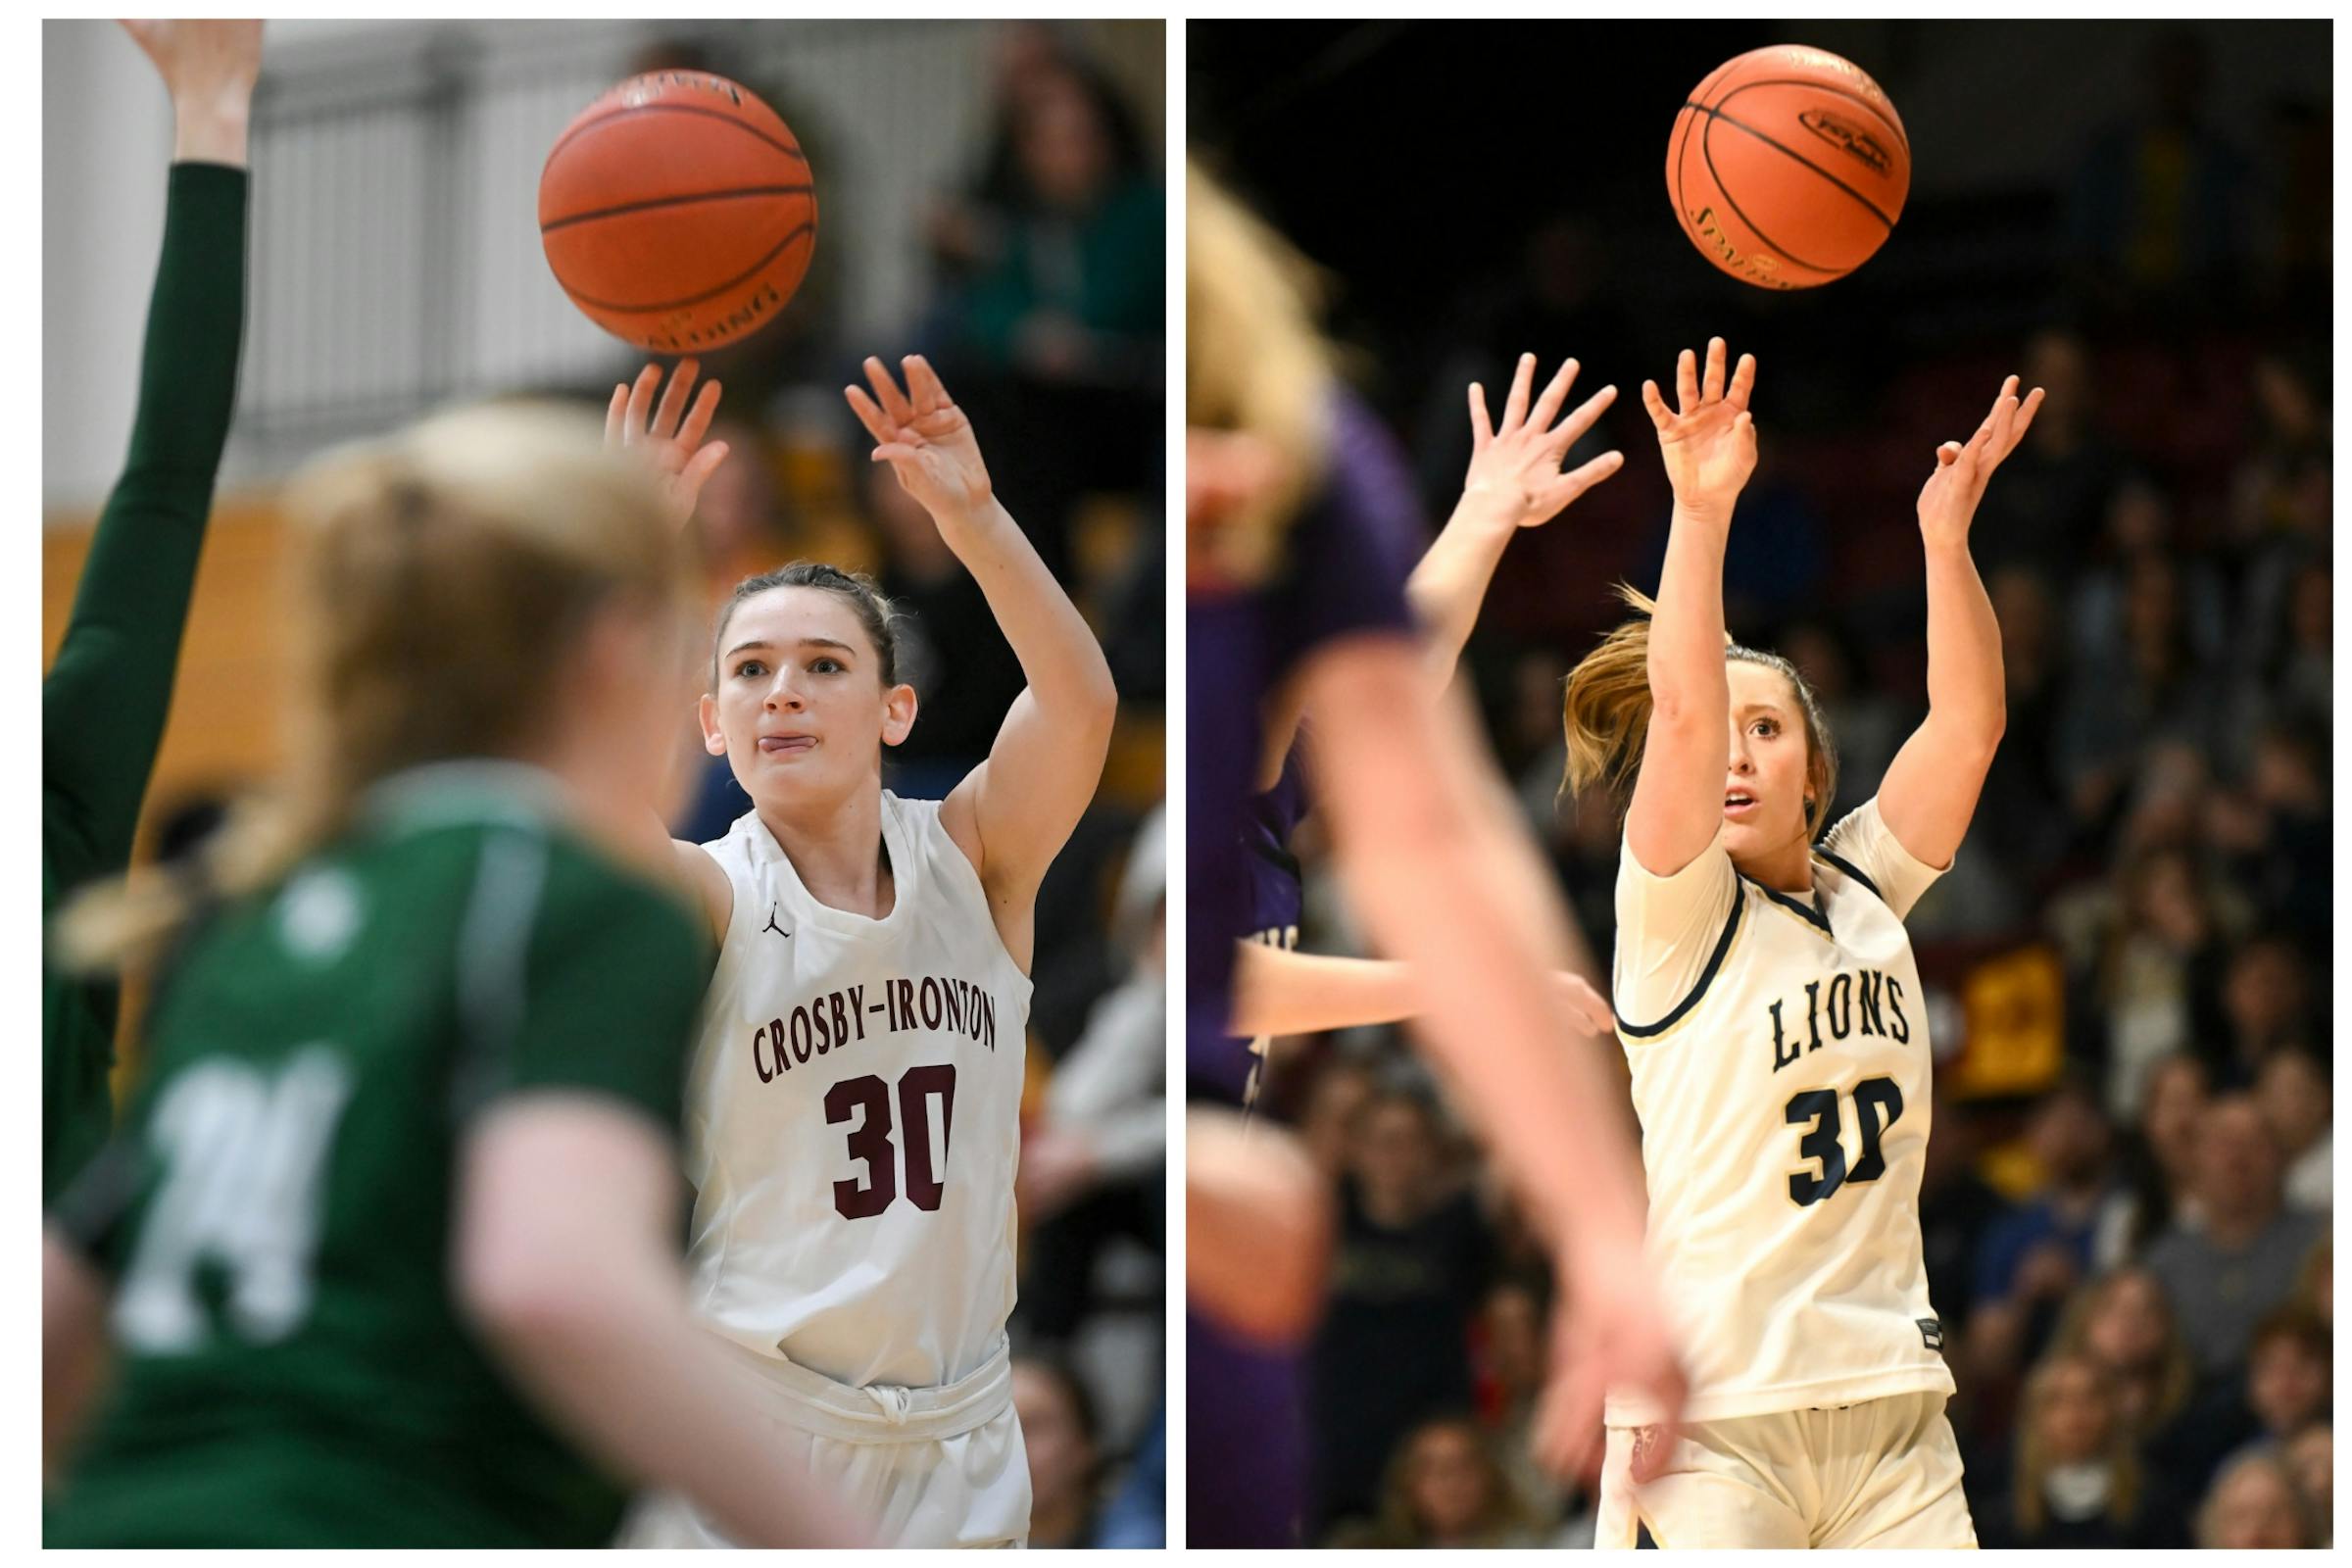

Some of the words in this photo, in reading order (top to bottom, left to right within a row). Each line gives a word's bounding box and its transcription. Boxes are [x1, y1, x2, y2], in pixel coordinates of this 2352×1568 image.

[753, 976, 996, 1085] CROSBY-IRONTON
[1768, 969, 1910, 1074] LIONS
[823, 1063, 957, 1221] 30
[1784, 1075, 1904, 1207] 30
